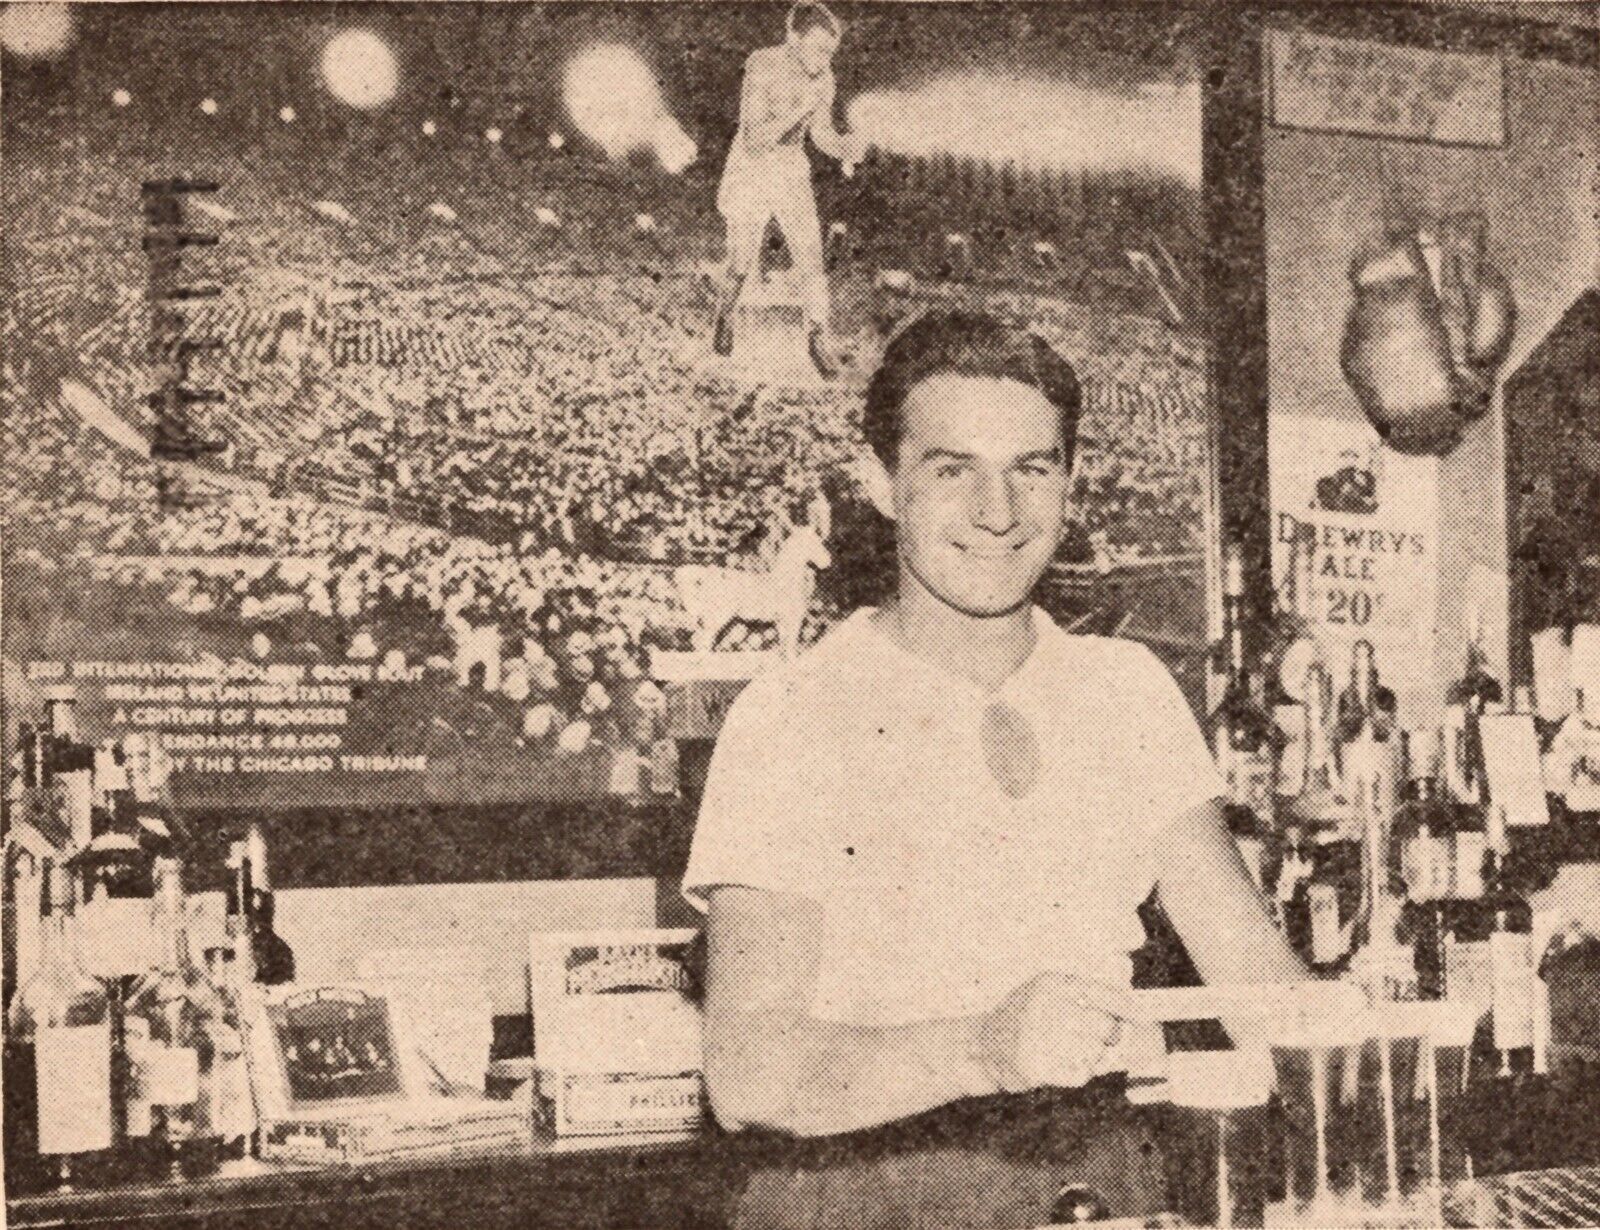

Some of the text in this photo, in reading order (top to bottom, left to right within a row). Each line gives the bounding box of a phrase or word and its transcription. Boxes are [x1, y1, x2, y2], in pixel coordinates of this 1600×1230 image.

[1279, 512, 1424, 554] DEWRYS
[1320, 553, 1375, 581] ALE
[113, 707, 348, 726] A CENTURY OF PROGRESS
[194, 756, 233, 773] THE
[239, 755, 333, 773] CHICAGO
[340, 755, 427, 772] TRIBUNE
